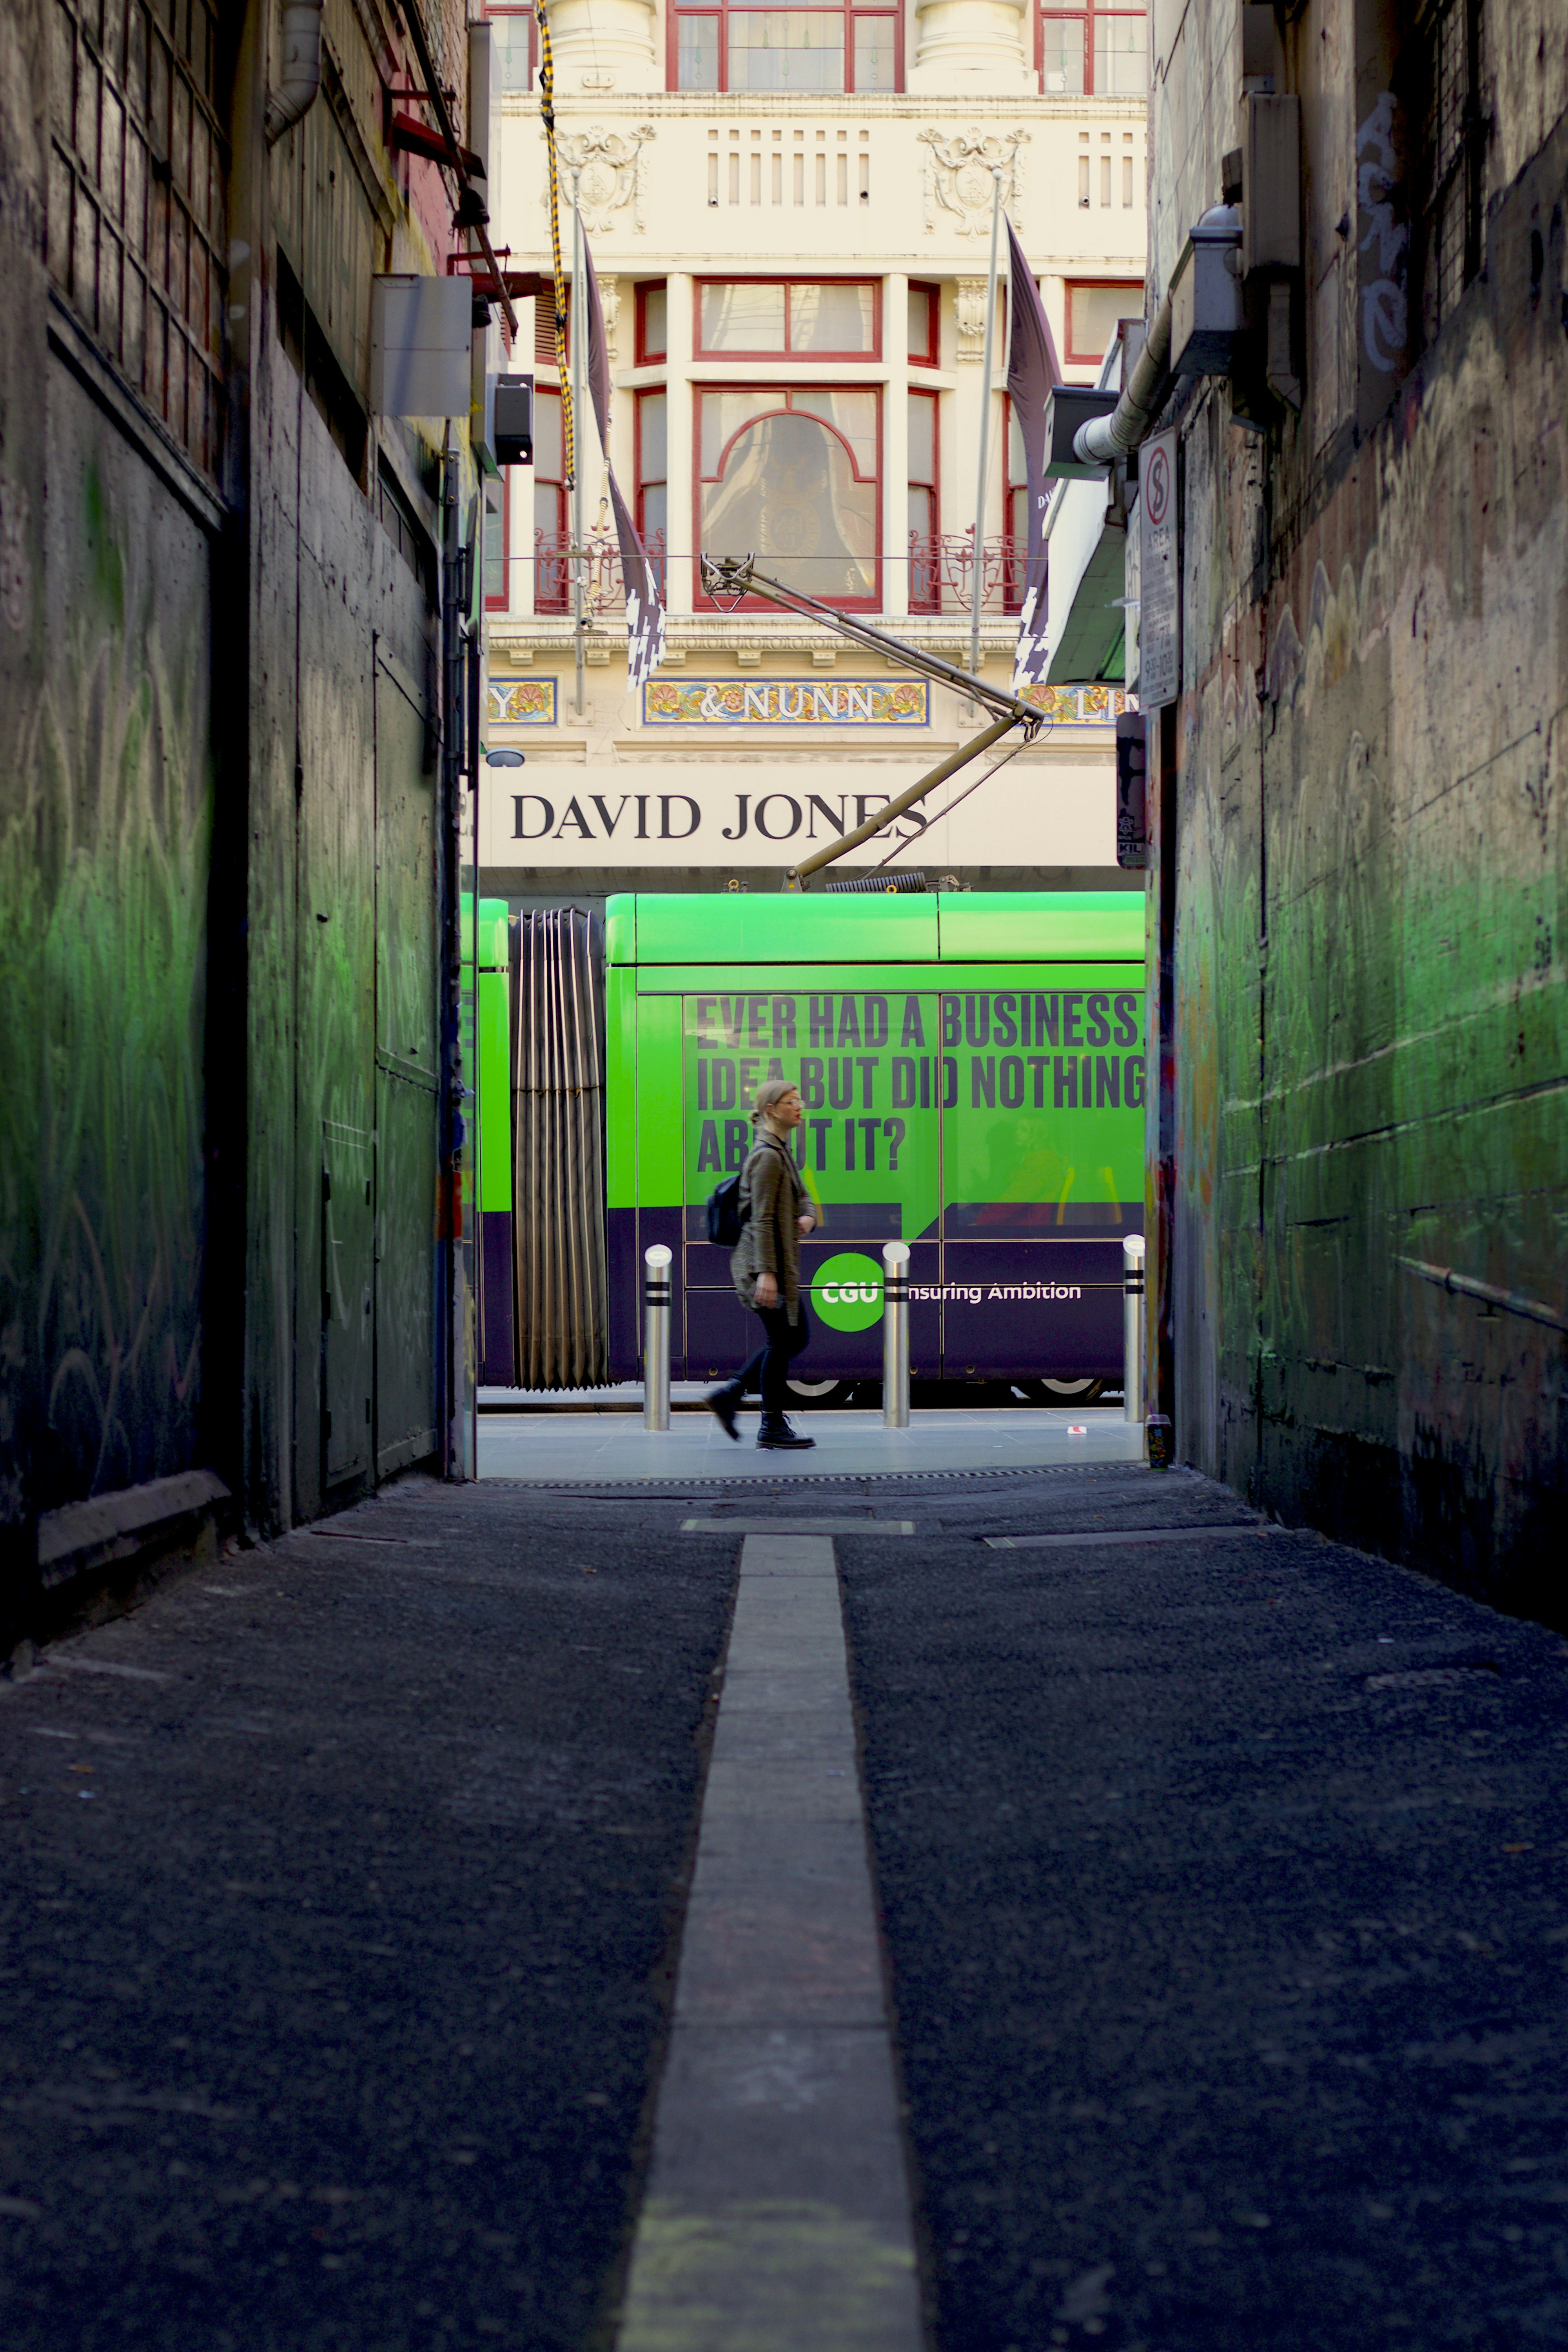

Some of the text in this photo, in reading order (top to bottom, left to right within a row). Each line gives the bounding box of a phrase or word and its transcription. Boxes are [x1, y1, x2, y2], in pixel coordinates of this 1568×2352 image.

[1147, 524, 1171, 550] AREA
[700, 685, 875, 718] & NUNN
[510, 794, 927, 840] DAVID JONES
[697, 994, 1138, 1049] EVER HAD A BUSINESS
[800, 1056, 879, 1110] BUT
[892, 1056, 958, 1109] DID
[971, 1055, 1145, 1109] NOTHING
[697, 1117, 906, 1172] ABUT IT?
[822, 1281, 878, 1303] CGU
[987, 1281, 1082, 1300] Ambition
